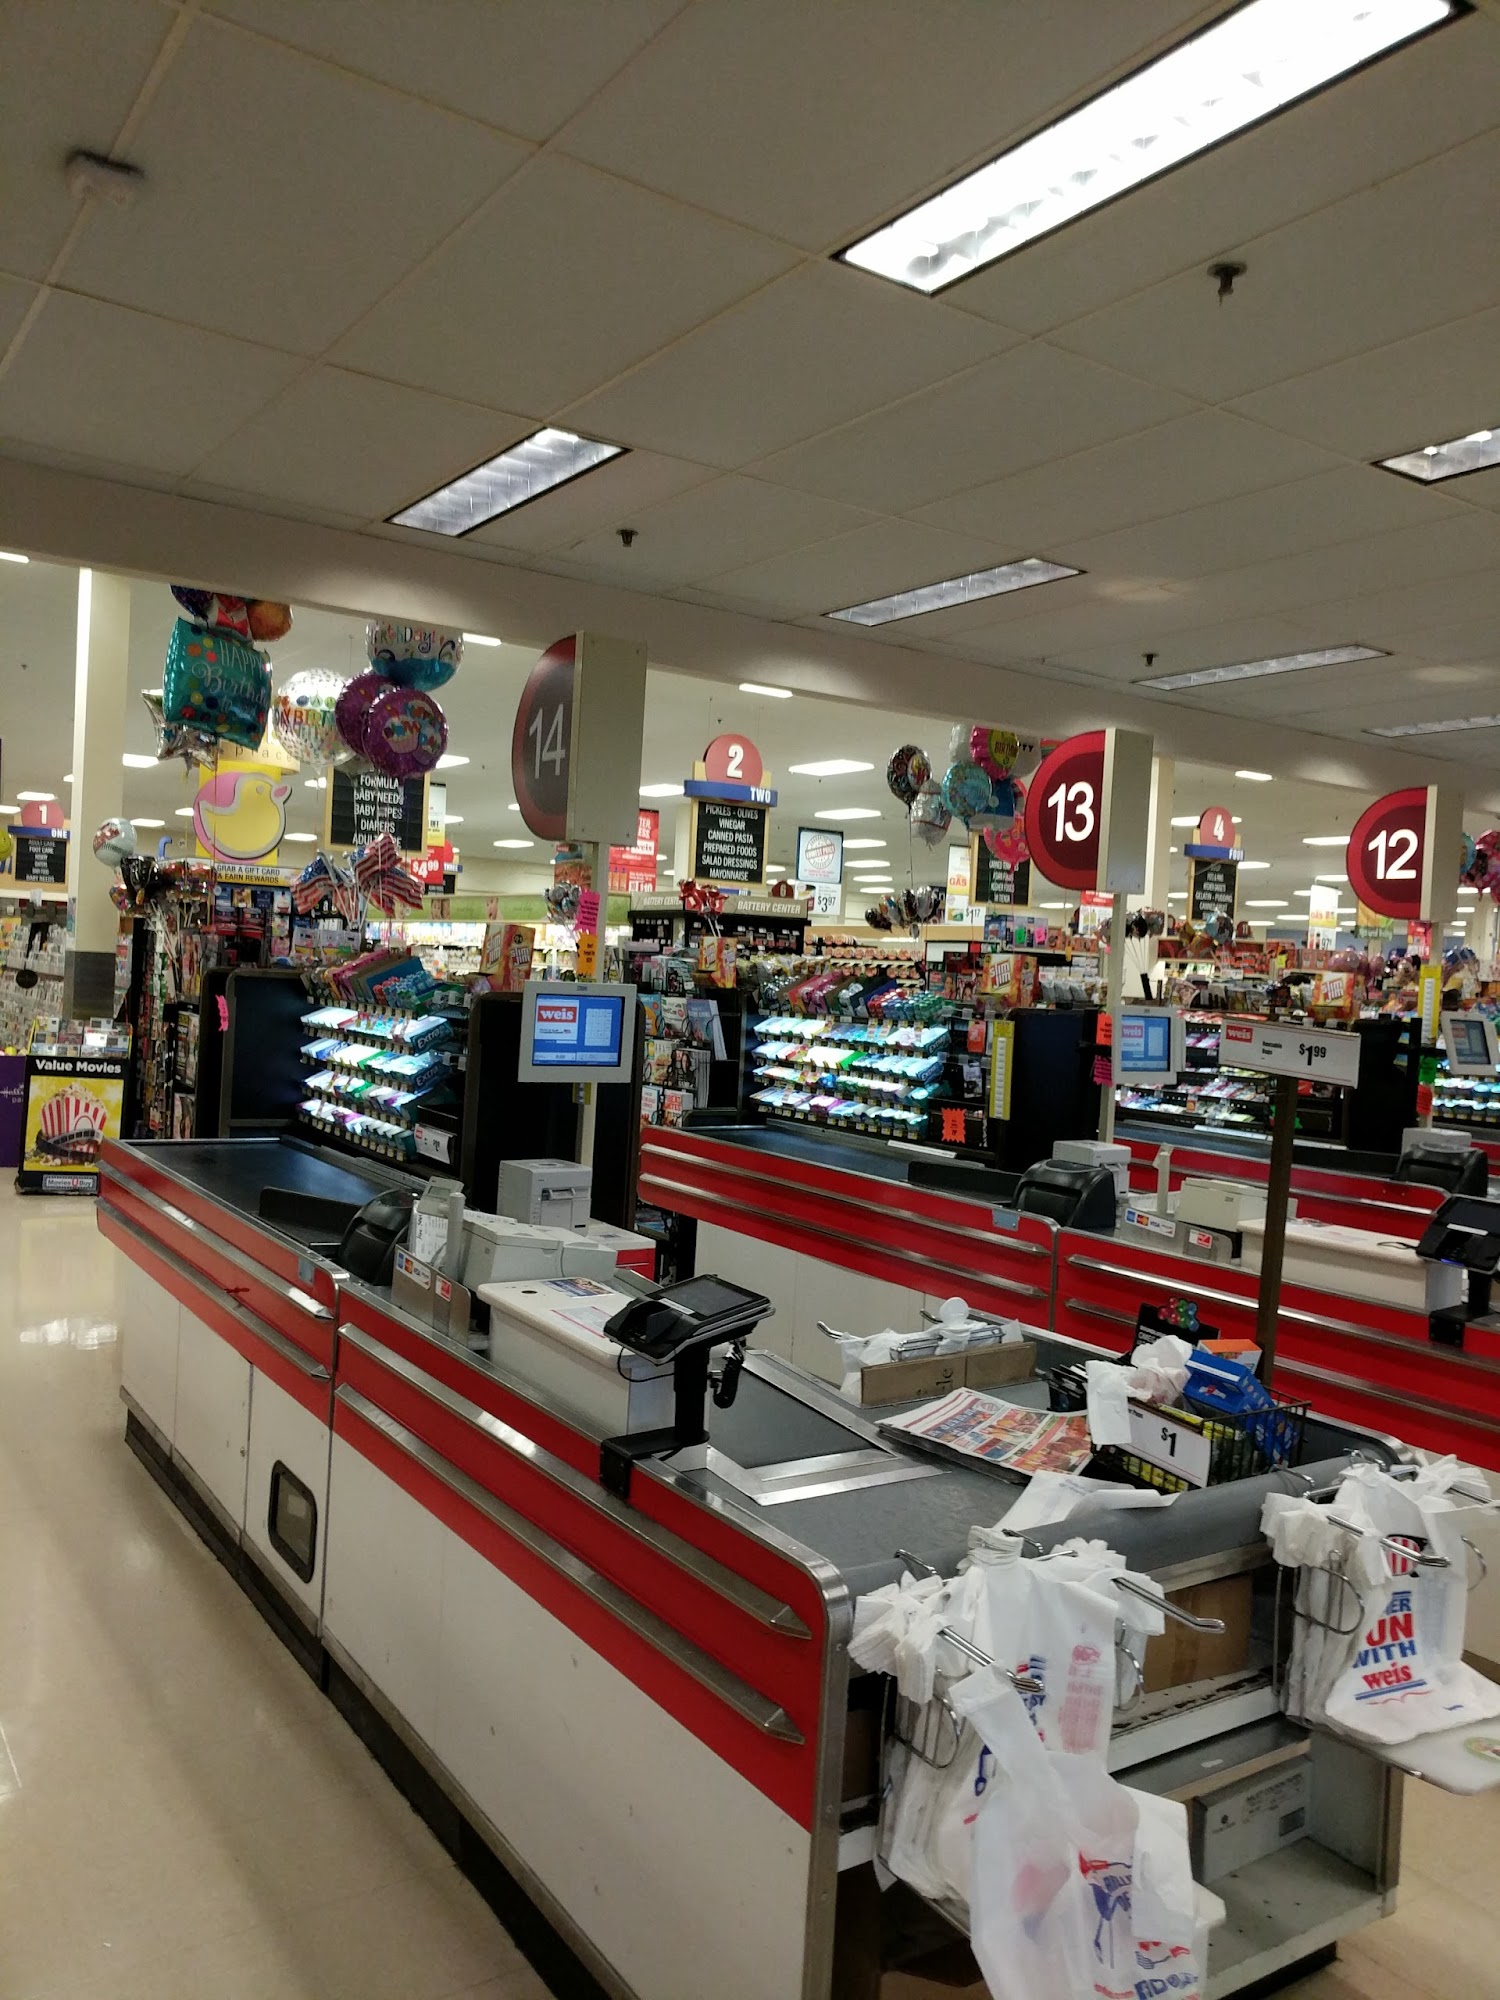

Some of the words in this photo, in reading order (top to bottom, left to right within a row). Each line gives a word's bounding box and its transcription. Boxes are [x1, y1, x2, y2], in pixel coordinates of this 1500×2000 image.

[529, 703, 566, 779] 14
[726, 743, 744, 779] 2
[360, 775, 399, 790] FORMULA
[750, 786, 771, 803] TWO
[39, 804, 48, 825] 1
[705, 804, 731, 817] PICKLES
[737, 807, 759, 820] OLIVES
[1047, 781, 1095, 842] 13
[360, 819, 396, 833] DIAPERS
[718, 818, 746, 831] VINEGAR
[1213, 814, 1225, 842] 4
[51, 829, 68, 839] ONE
[707, 830, 734, 843] CANNED
[734, 833, 754, 844] PASTA
[703, 842, 735, 855] PREPARED
[736, 845, 757, 858] FOODS
[1368, 829, 1418, 880] 12
[217, 864, 236, 873] GRAB
[245, 867, 260, 875] GIFT
[262, 868, 280, 876] CARD
[702, 855, 722, 866] SALAD
[723, 857, 758, 870] DRESSINGS
[225, 873, 243, 881] EARN
[246, 875, 279, 884] REWARDS
[709, 868, 749, 881] MAYONNAISE
[949, 877, 967, 887] GAS
[737, 900, 771, 912] BATTERY
[771, 902, 801, 914] CENTER
[817, 895, 836, 913] $397
[990, 961, 1010, 977] slim
[993, 972, 1011, 989] jim
[540, 1008, 574, 1020] weis
[1123, 1027, 1142, 1037] weis
[1228, 1028, 1251, 1040] weis
[1299, 1043, 1327, 1066] $199
[36, 1059, 73, 1072] Value
[76, 1061, 122, 1074] Movies
[48, 1179, 70, 1187] Movies
[80, 1180, 91, 1188] Buy
[1149, 1220, 1160, 1228] VISA
[1161, 1426, 1177, 1458] $1
[1362, 1662, 1412, 1691] weis
